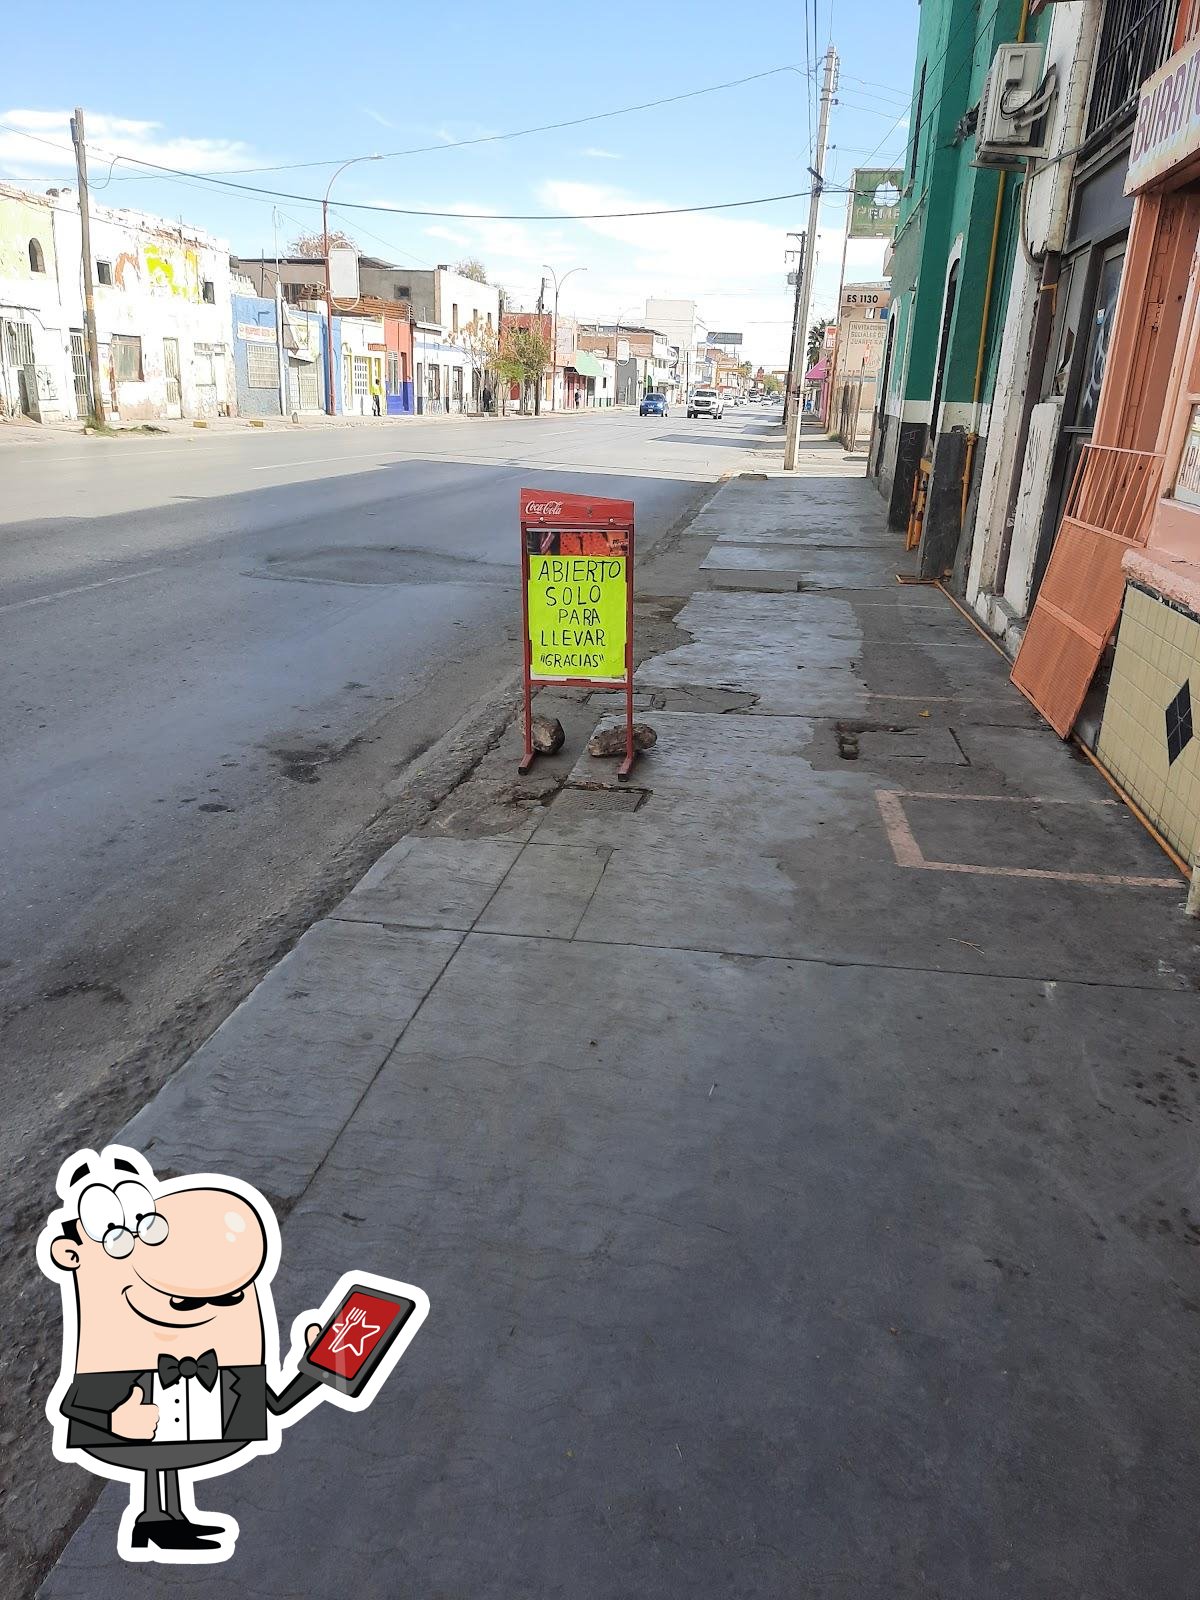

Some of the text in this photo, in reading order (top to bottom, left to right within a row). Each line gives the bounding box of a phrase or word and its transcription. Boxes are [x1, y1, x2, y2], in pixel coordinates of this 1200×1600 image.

[1132, 49, 1200, 164] BURRIT
[860, 294, 879, 304] 1130
[537, 559, 621, 583] ABIERTO
[545, 584, 601, 607] SOLO
[558, 608, 601, 626] PARA
[541, 628, 606, 647] LLEVAR
[540, 653, 605, 669] "GRACIAS"
